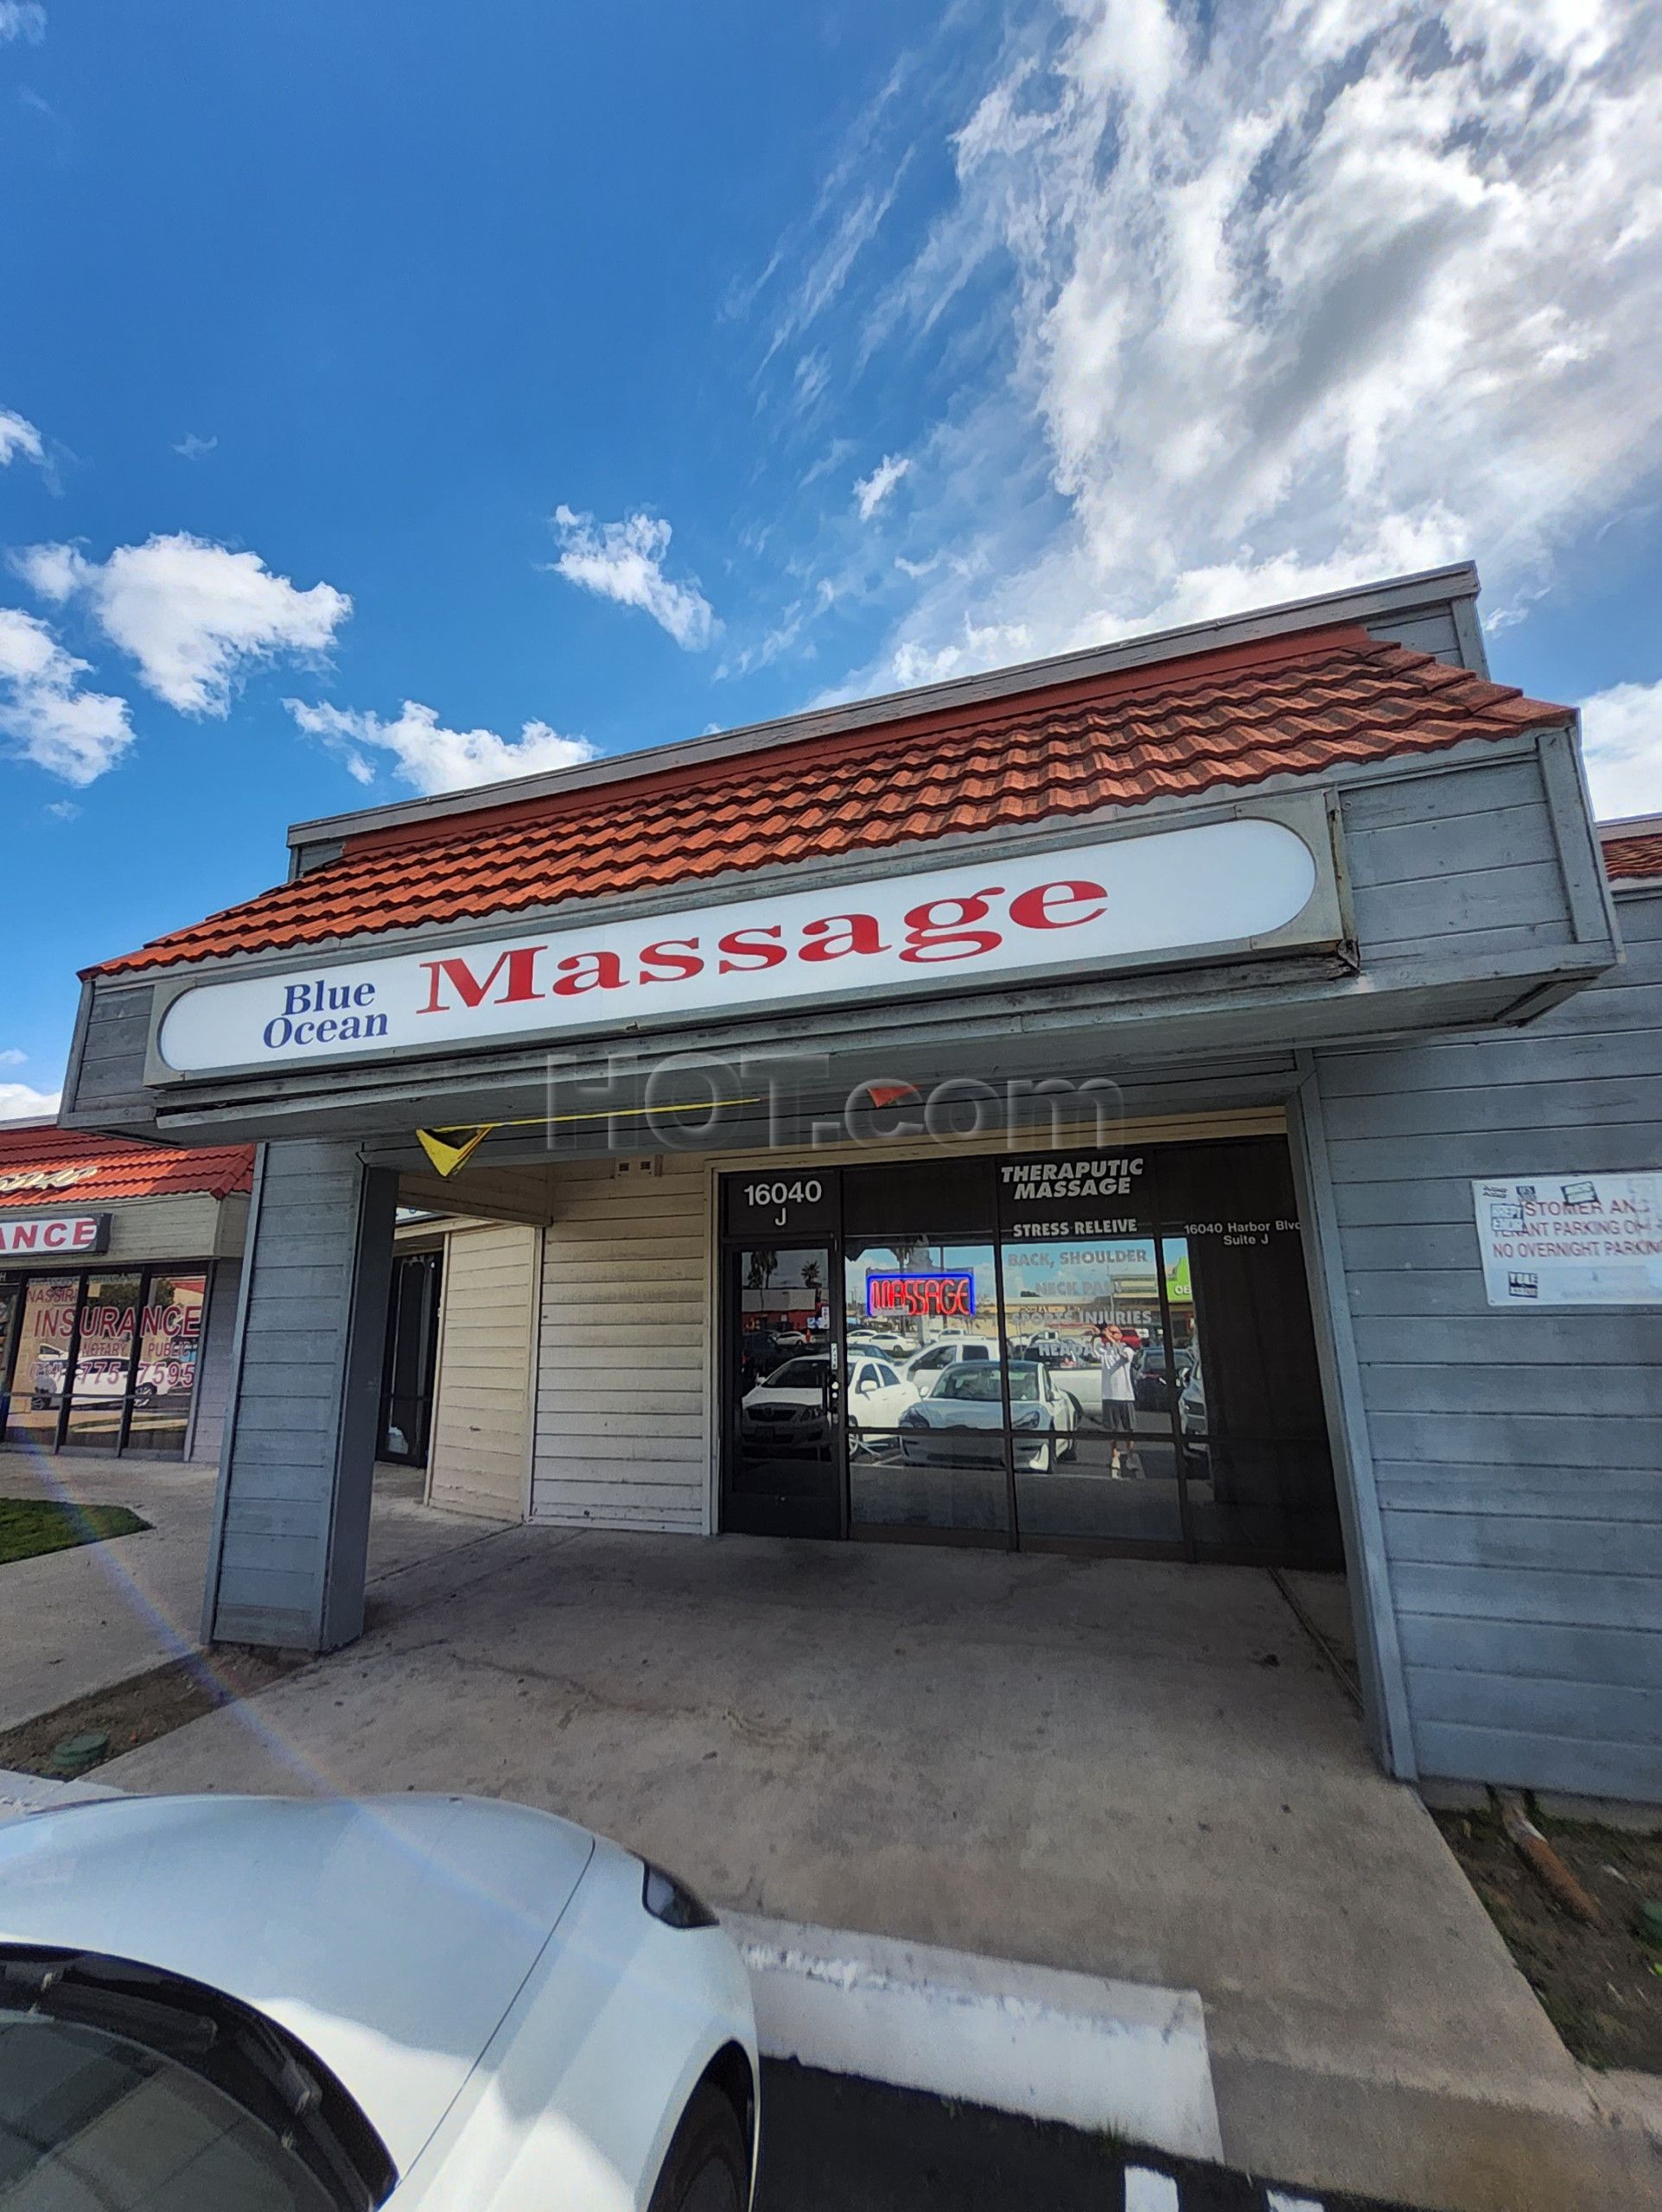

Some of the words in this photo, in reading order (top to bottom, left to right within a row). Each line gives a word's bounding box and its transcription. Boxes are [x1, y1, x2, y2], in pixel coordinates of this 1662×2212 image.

[416, 880, 1108, 1014] Massage
[281, 979, 375, 1016] Blue
[263, 1012, 388, 1050] Ocean
[1001, 1158, 1143, 1183] THERAPUTIC
[744, 1180, 822, 1206] 16040
[1014, 1177, 1131, 1200] MASSAGE
[774, 1207, 787, 1226] J
[1523, 1200, 1603, 1217] STOMER
[0, 1221, 97, 1250] NCE
[1013, 1222, 1070, 1237] STRESS
[1074, 1218, 1137, 1235] RELEIVE
[1184, 1223, 1223, 1235] 16040
[1228, 1222, 1270, 1233] Harbor
[1223, 1235, 1257, 1246] Suite
[1261, 1233, 1269, 1245] J
[1492, 1242, 1513, 1258] NO
[1517, 1240, 1601, 1258] OVERNIGHT
[1604, 1239, 1662, 1256] PARKIN
[1060, 1249, 1148, 1265] SHOULDER
[870, 1278, 970, 1316] MASSAGE
[1035, 1281, 1079, 1297] NECK
[33, 1304, 202, 1338] INSURANCE
[1081, 1310, 1152, 1325] INJURIES
[82, 1342, 128, 1357] NOTARY
[148, 1342, 192, 1357] PUBLIC
[80, 1361, 122, 1385] 775
[137, 1361, 194, 1388] 7595
